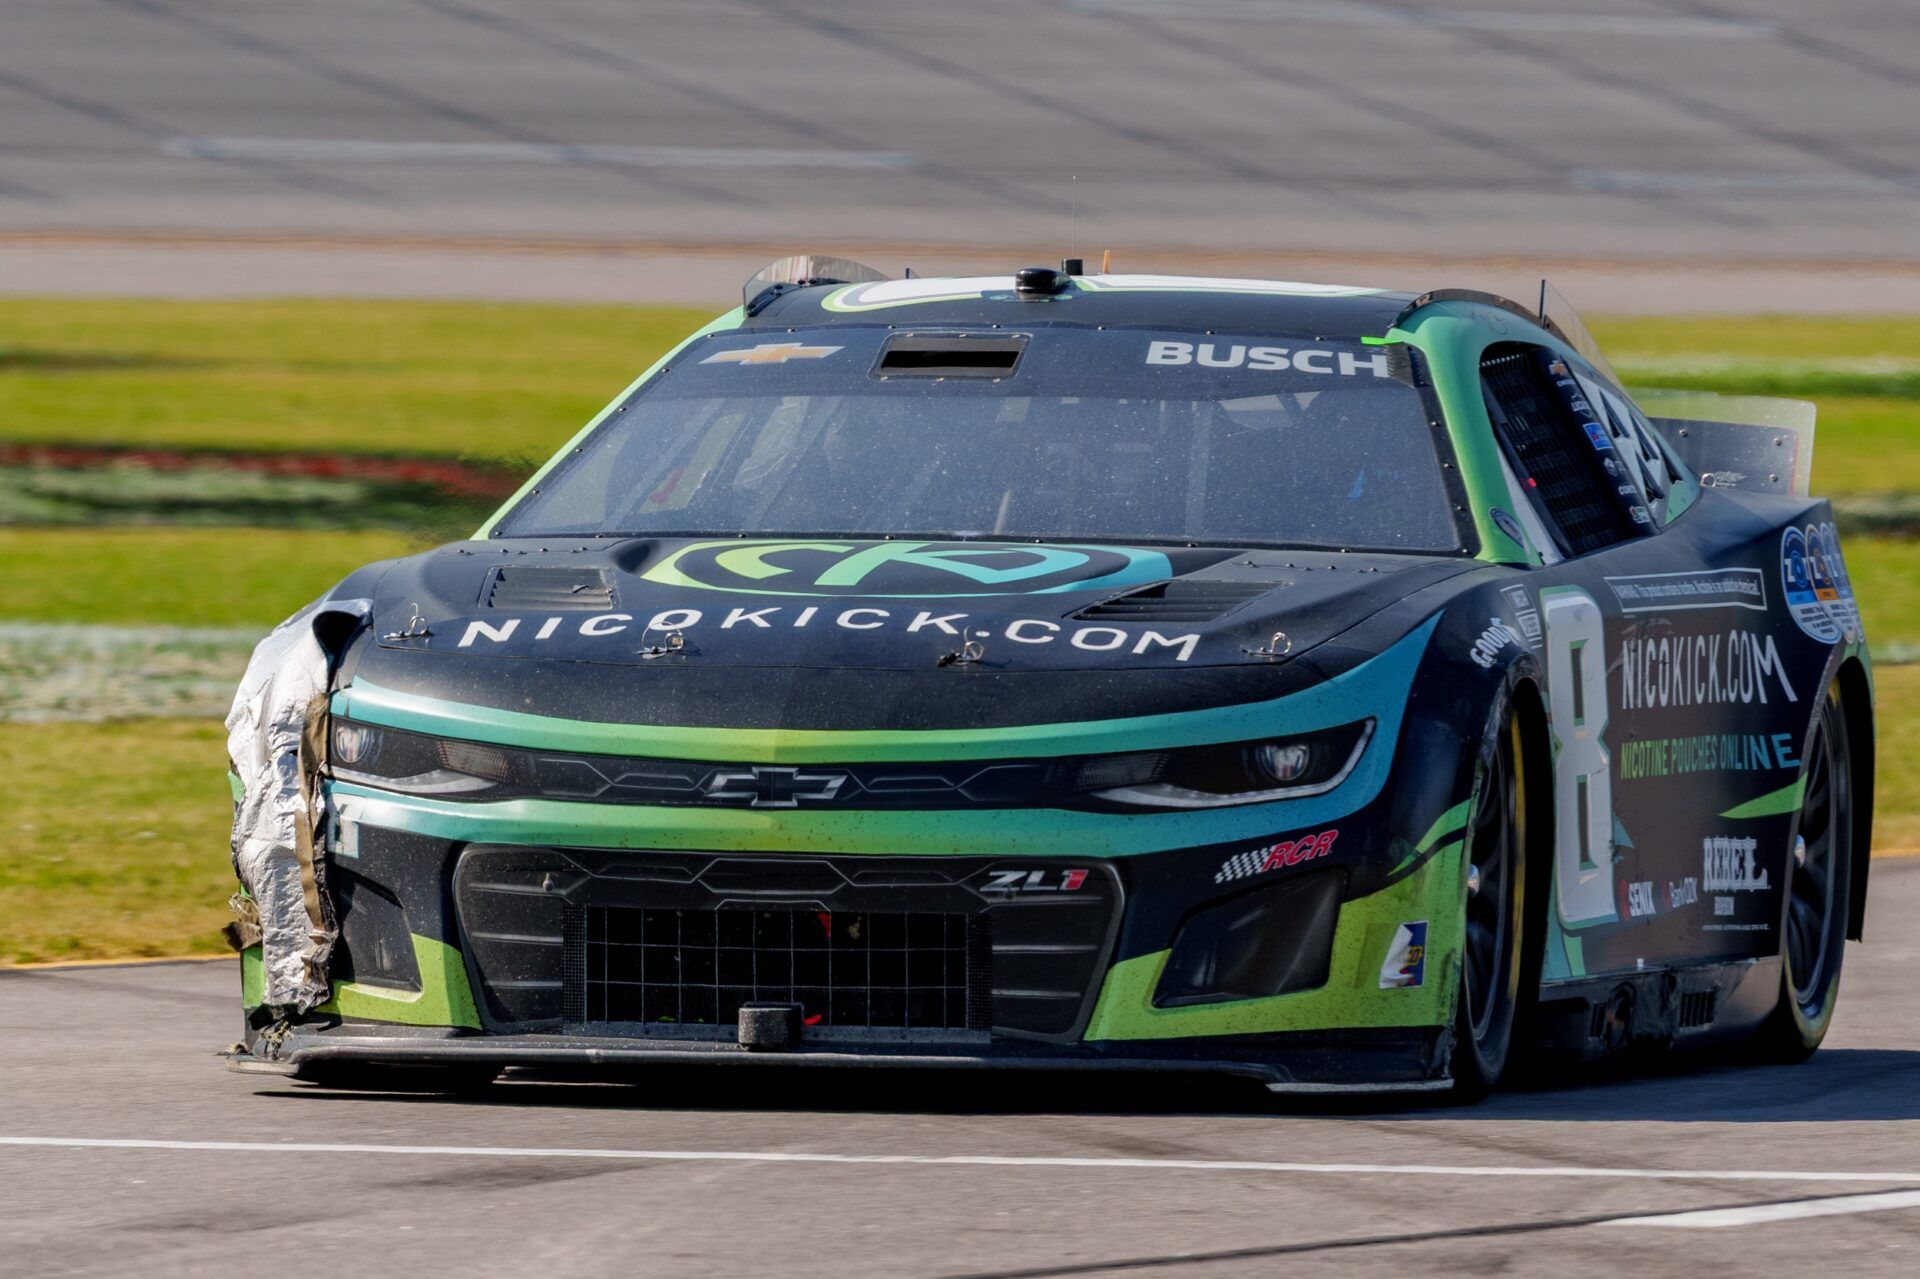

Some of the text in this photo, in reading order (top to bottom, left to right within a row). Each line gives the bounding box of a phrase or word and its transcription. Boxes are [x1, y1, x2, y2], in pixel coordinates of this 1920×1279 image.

[1145, 341, 1389, 378] BUSCH
[457, 605, 1201, 663] NICOKICK.COM
[1622, 629, 1799, 710] NICOKICK.COM
[1540, 584, 1621, 932] 8
[1620, 732, 1802, 780] NICOTINE POUCHES ONLINE
[1263, 829, 1339, 871] RCR
[1703, 836, 1771, 892] REBEL
[980, 869, 1089, 893] ZL1
